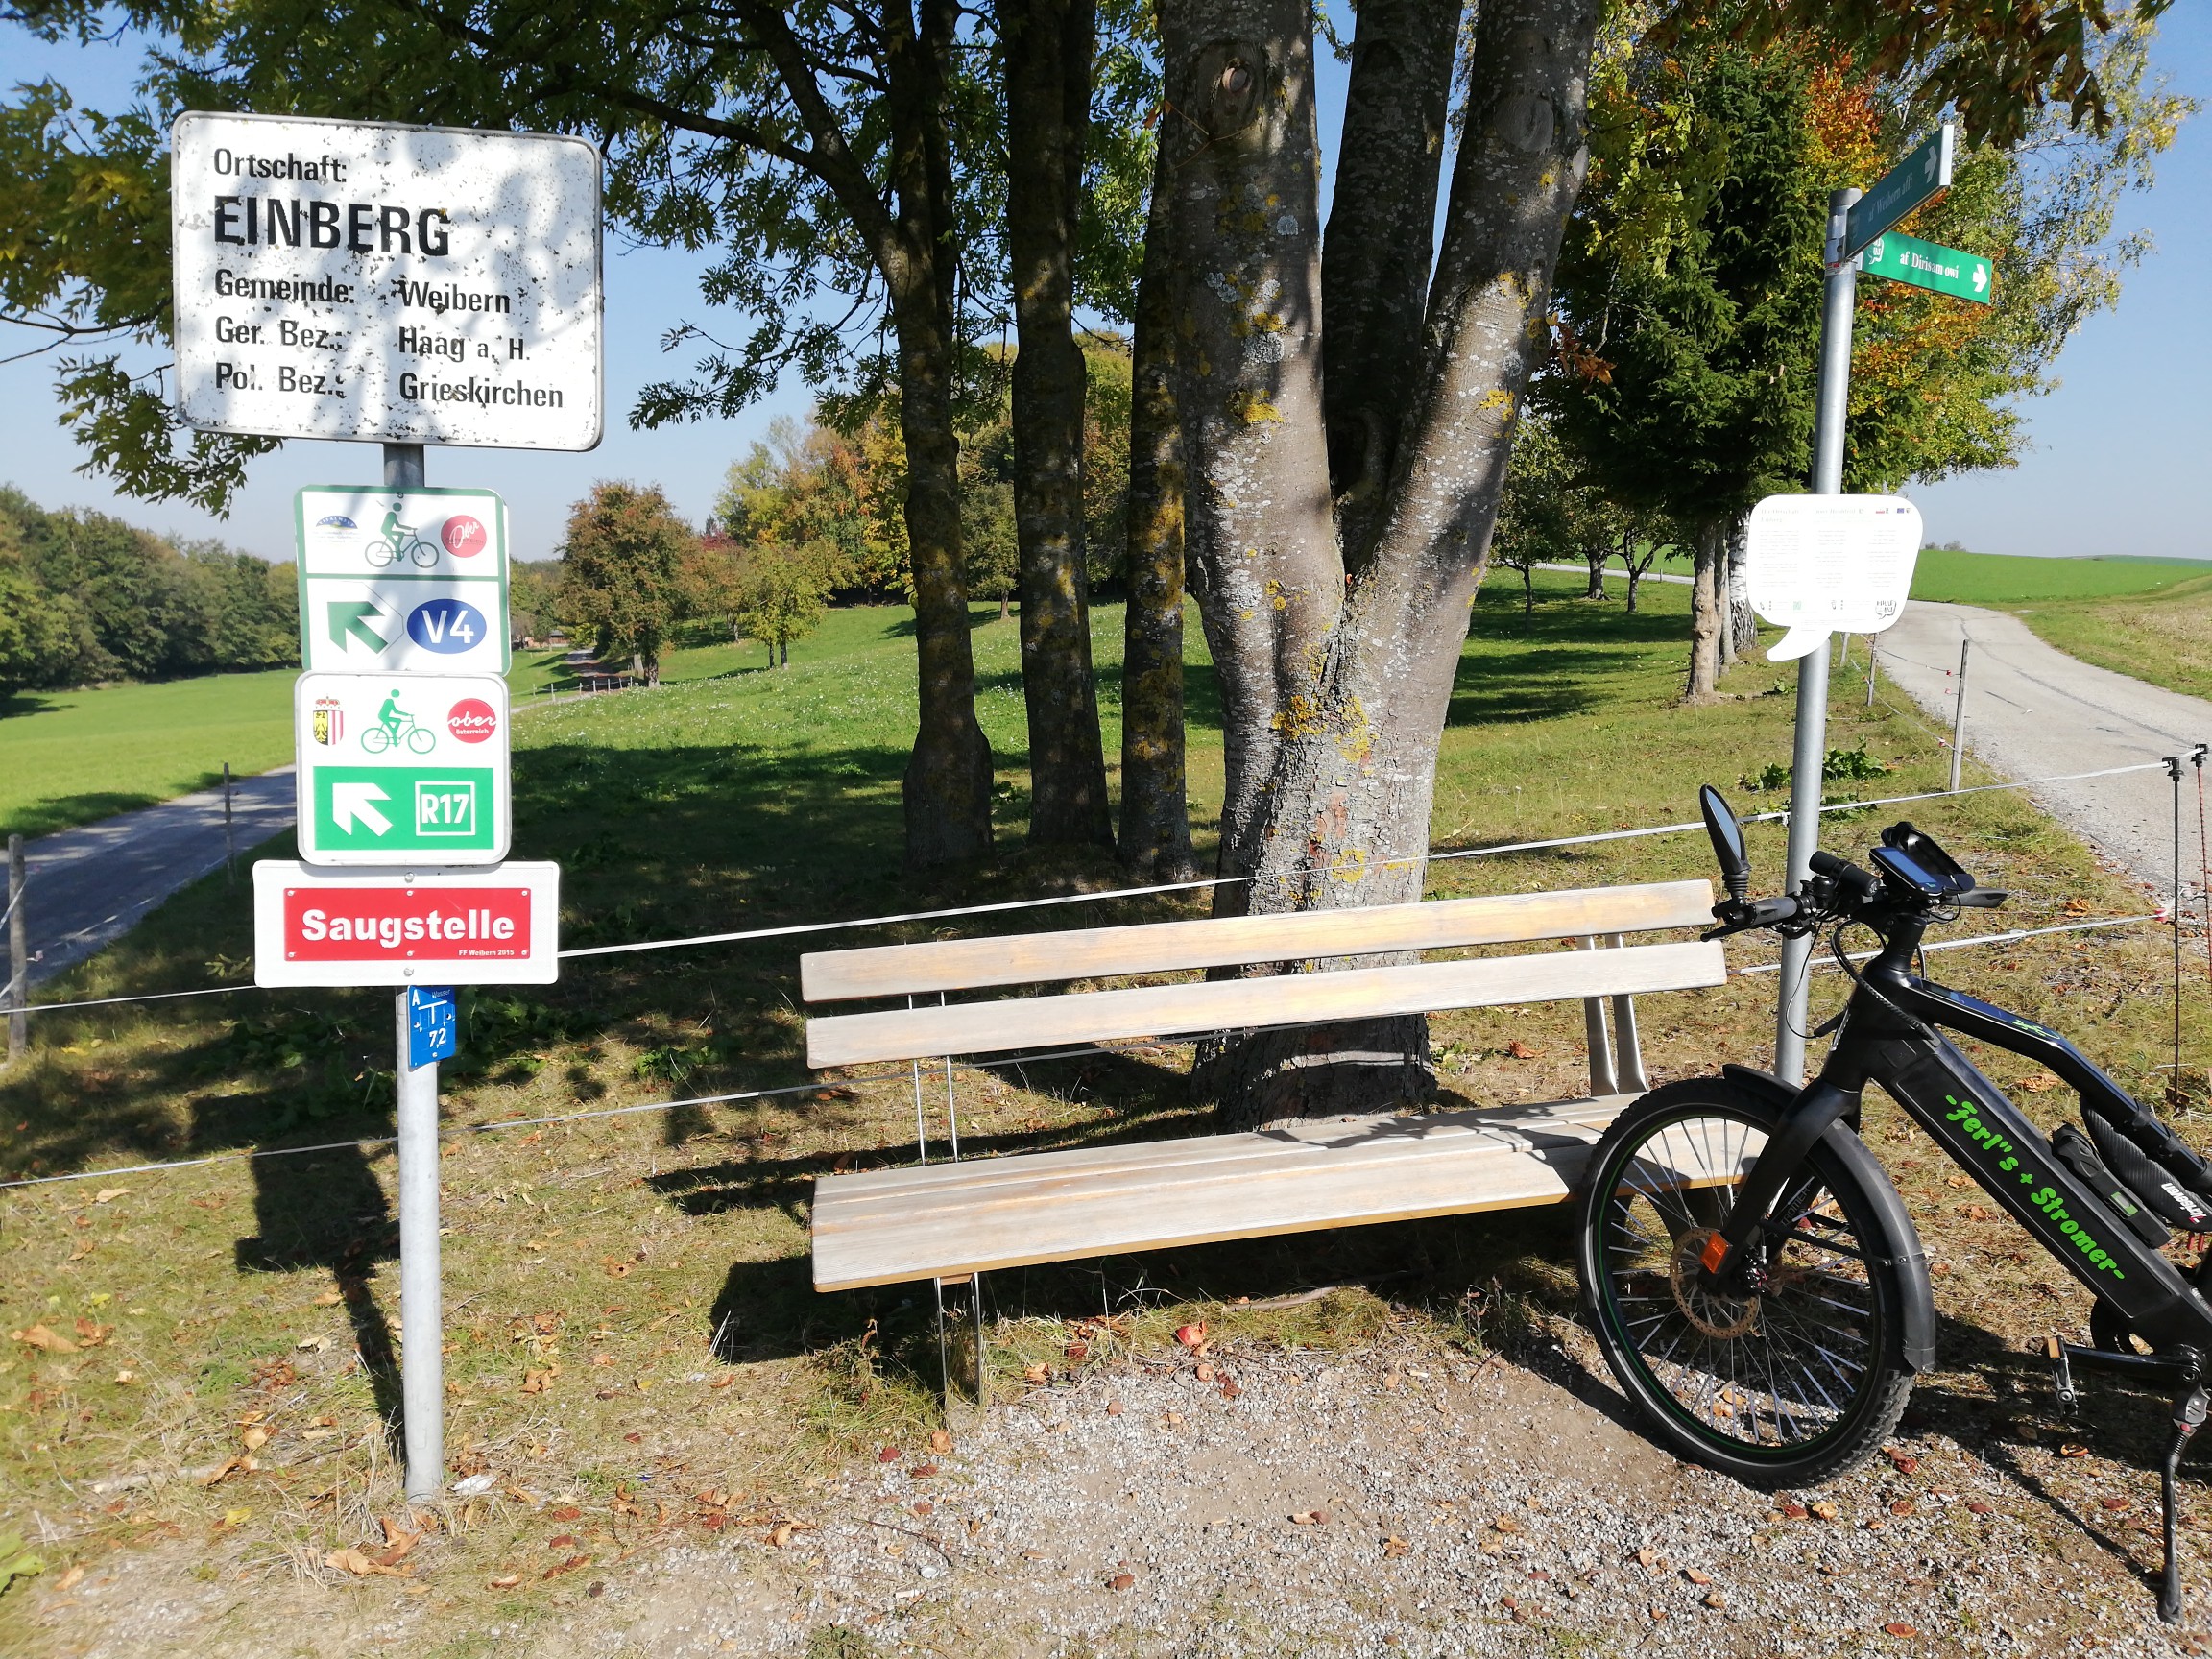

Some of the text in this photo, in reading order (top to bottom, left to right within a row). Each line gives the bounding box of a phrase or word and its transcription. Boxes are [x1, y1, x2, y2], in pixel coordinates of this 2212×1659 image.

[213, 148, 348, 183] Ortschaft:
[214, 195, 450, 256] EINBERG
[1899, 251, 1959, 279] af Dirisam owi
[214, 269, 511, 314] Gemeinde: Weibern
[215, 316, 531, 362] Ger. Bez.: Haag a. H.
[215, 362, 564, 408] Pol. Bez.: Grieskirchen
[449, 521, 480, 549] Ober
[421, 610, 475, 644] V4
[447, 710, 496, 727] ober
[421, 793, 469, 824] R17
[301, 909, 515, 949] Saugstelle
[412, 989, 421, 1006] A
